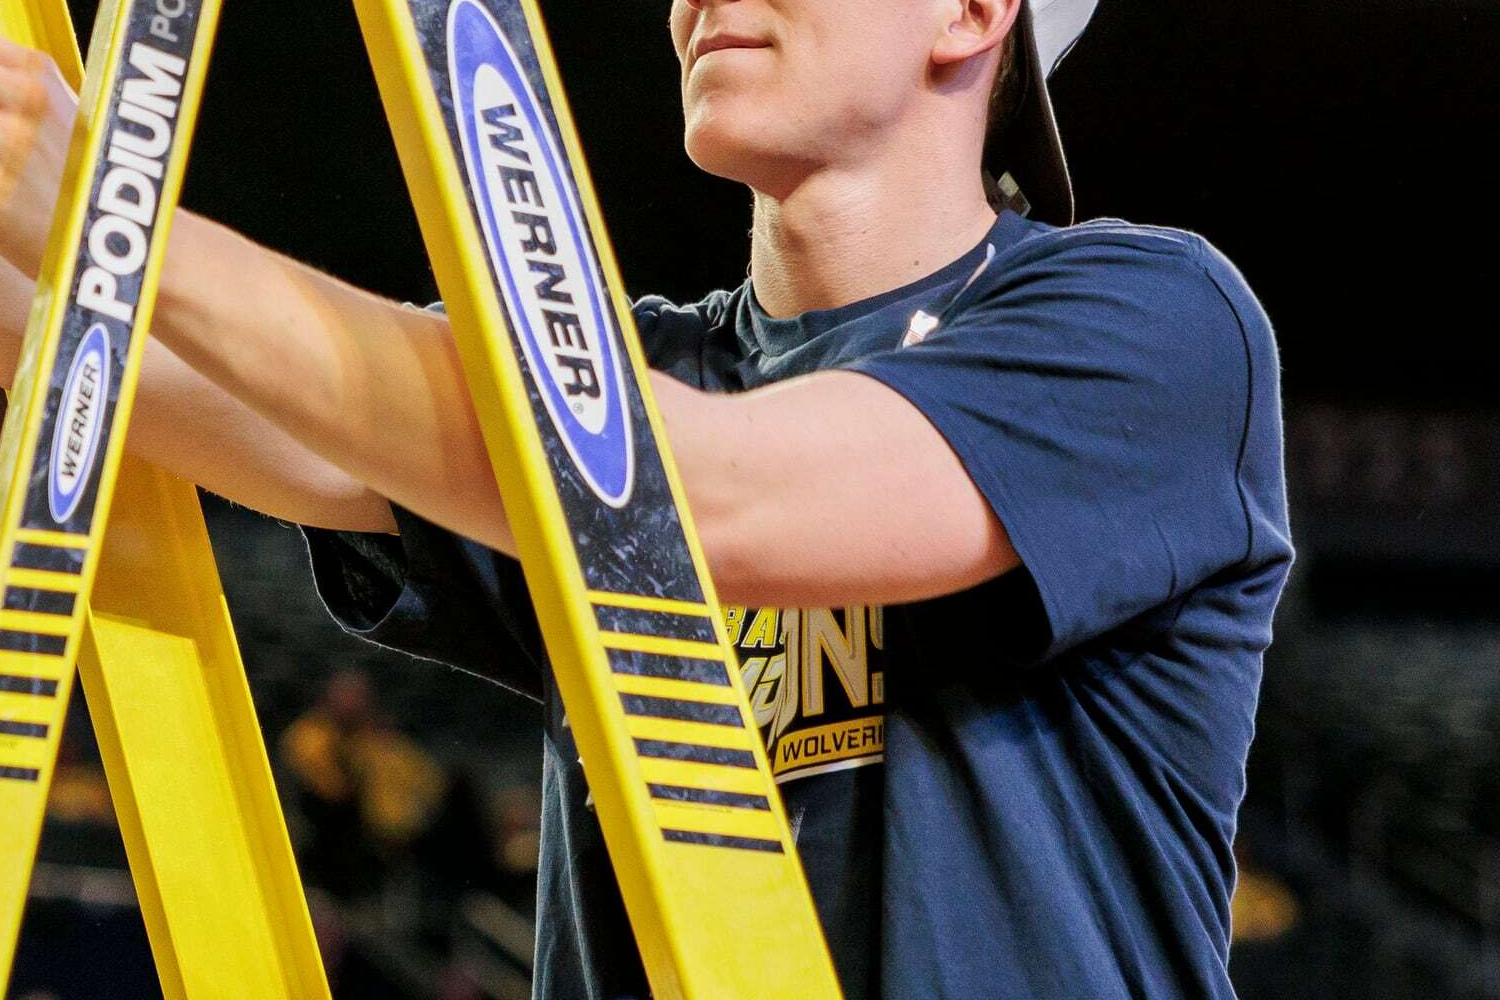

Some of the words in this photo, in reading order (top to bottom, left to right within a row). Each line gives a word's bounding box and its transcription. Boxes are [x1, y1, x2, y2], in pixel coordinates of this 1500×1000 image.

[76, 41, 187, 322] PODIUM
[479, 102, 601, 401] WERNER
[61, 362, 98, 478] WERNER
